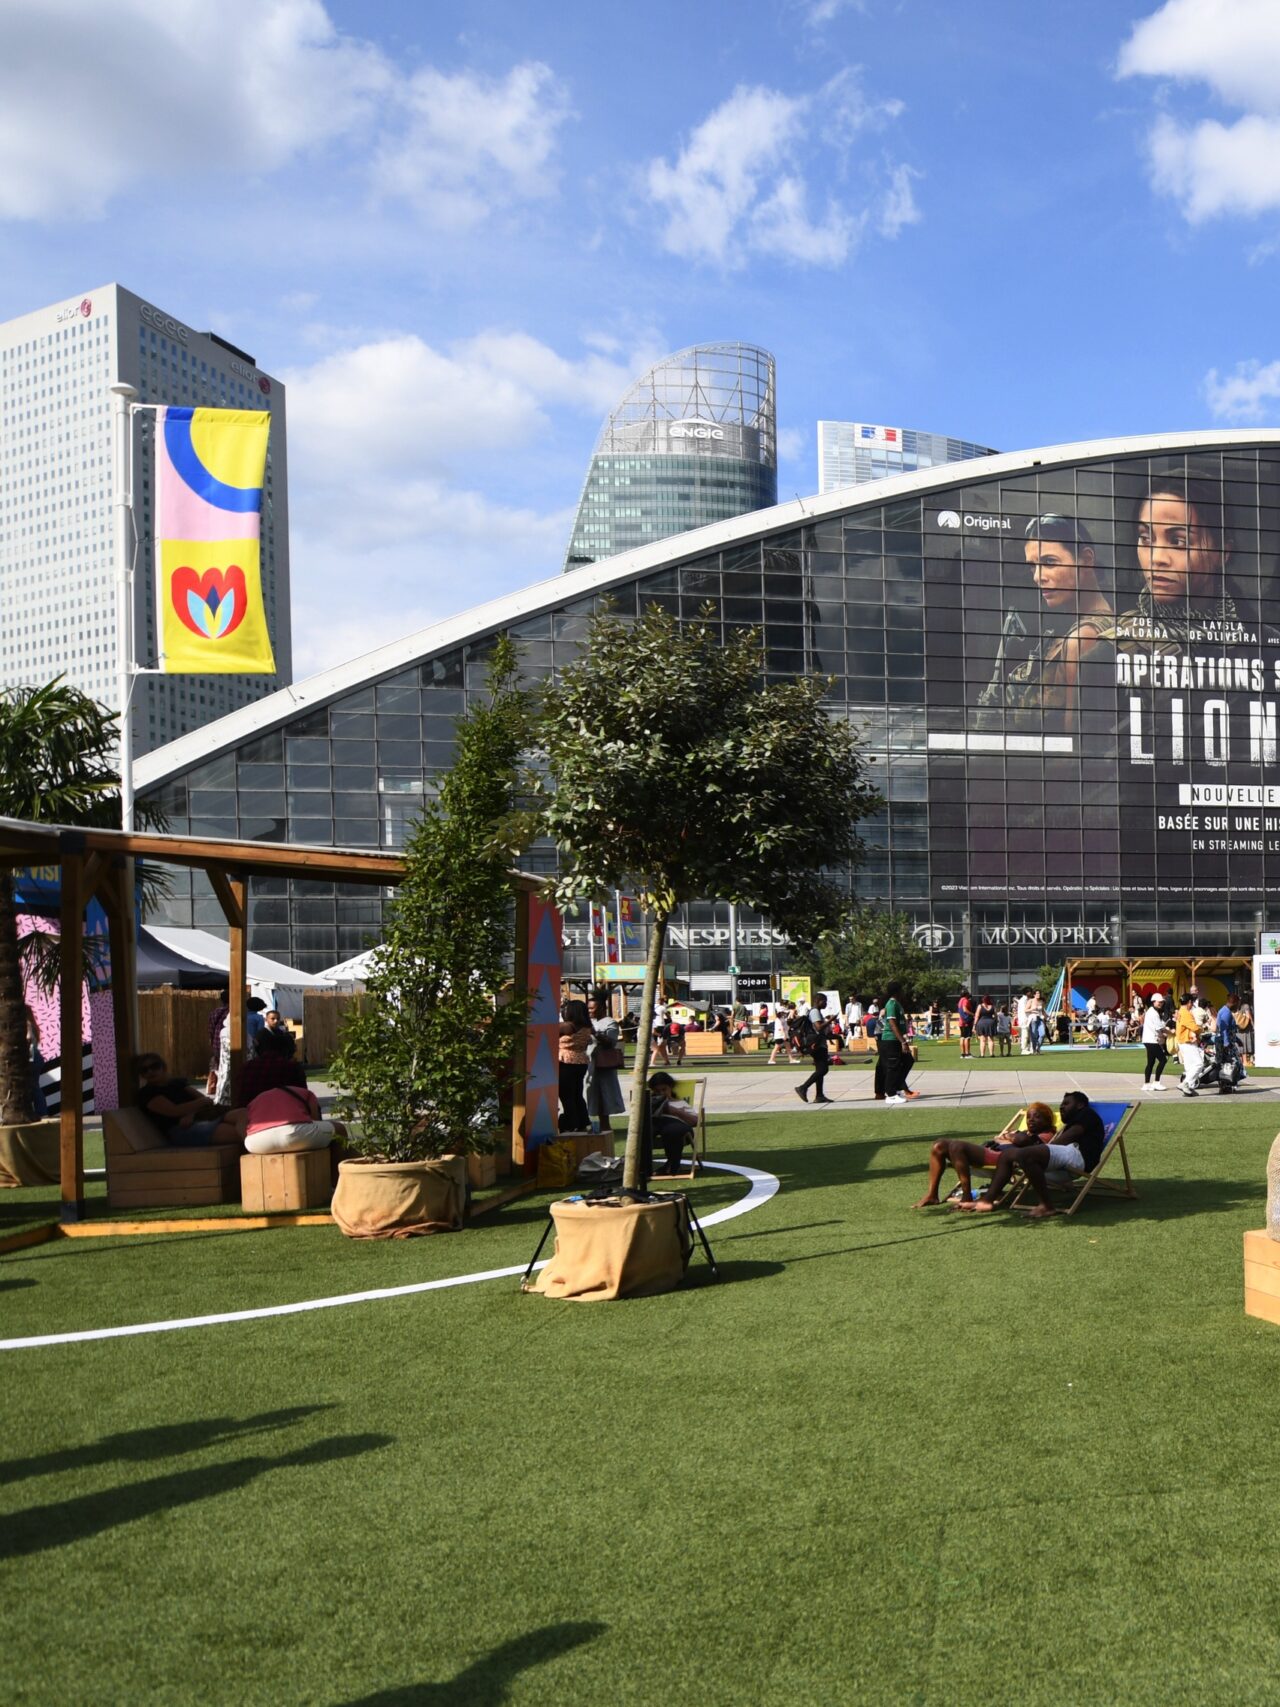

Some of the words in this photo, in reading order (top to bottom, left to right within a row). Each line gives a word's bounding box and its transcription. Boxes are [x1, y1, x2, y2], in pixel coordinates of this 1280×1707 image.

[963, 515, 1012, 530] Original
[1189, 630, 1202, 641] DE
[1207, 631, 1258, 643] OLIVEIRA
[1116, 650, 1265, 692] OPÉRATIONS
[1191, 786, 1275, 803] NOUVELLE
[1158, 812, 1200, 831] BASÉE
[1204, 816, 1229, 831] SUR
[1235, 817, 1260, 832] UNE
[1192, 839, 1205, 850] EN
[1209, 839, 1264, 851] STREAMING
[1268, 840, 1280, 851] LE
[981, 926, 1111, 945] MONOPRIX
[737, 978, 767, 987] cojean
